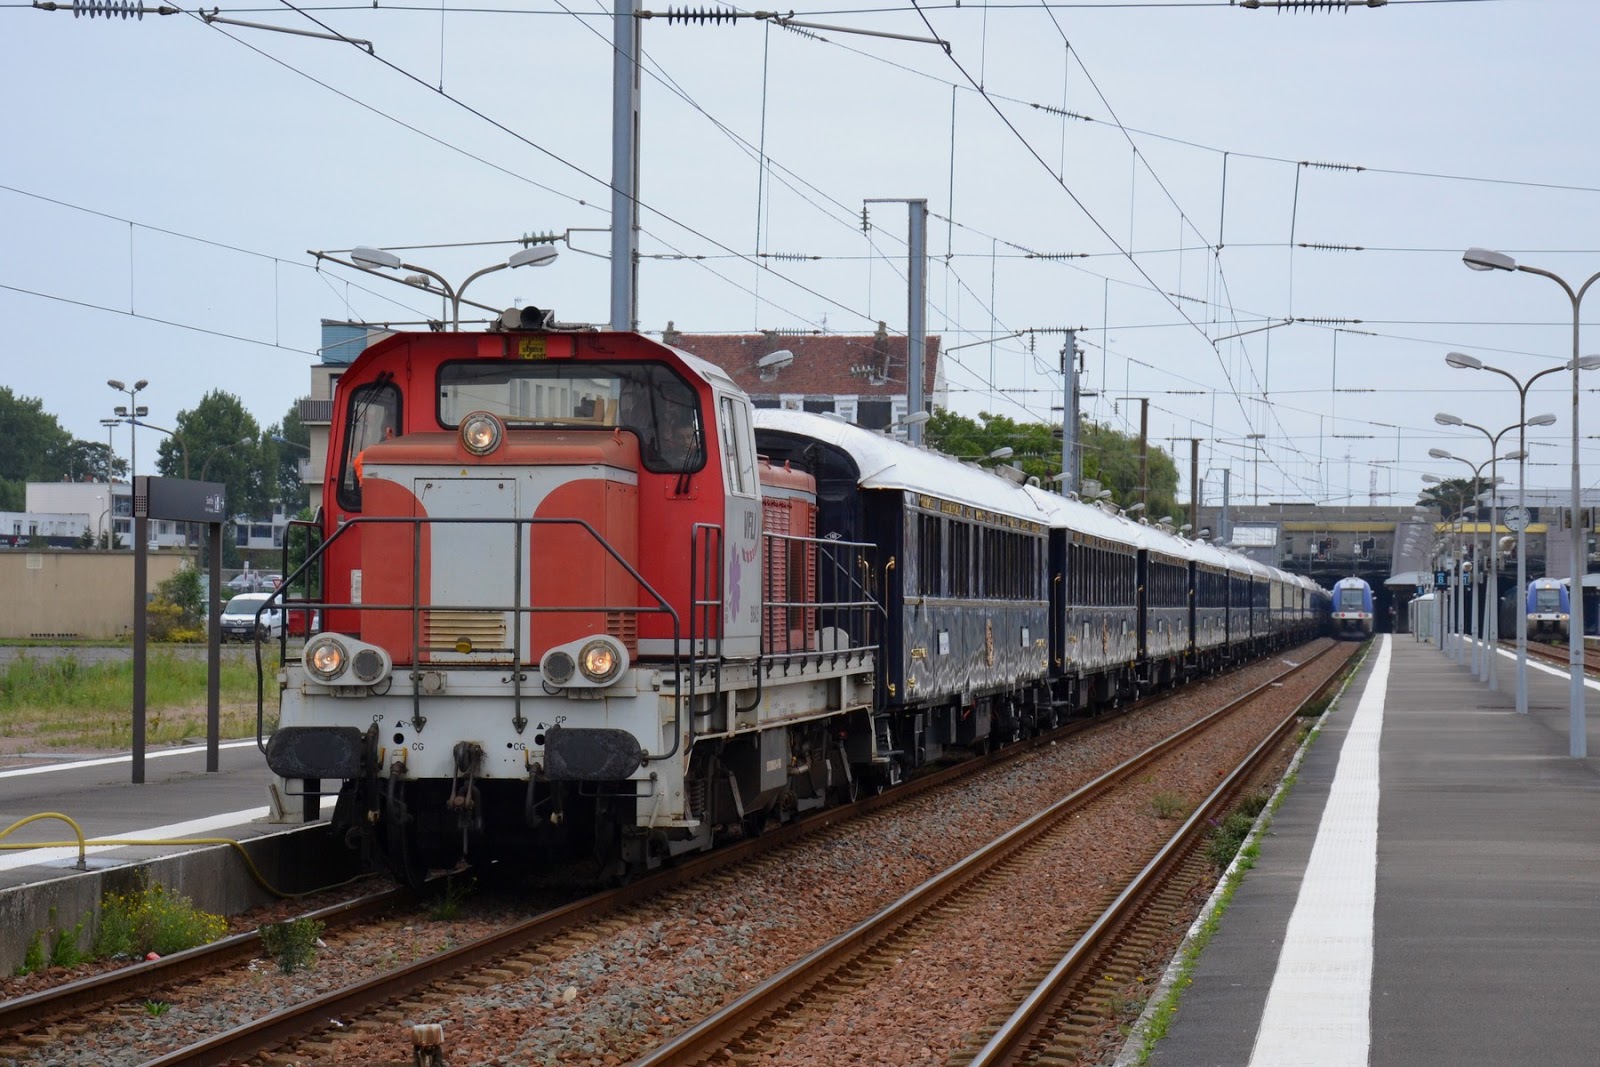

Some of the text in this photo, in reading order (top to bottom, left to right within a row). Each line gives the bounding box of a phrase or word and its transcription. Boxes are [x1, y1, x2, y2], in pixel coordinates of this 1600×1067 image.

[372, 714, 384, 723] CP
[555, 716, 567, 724] CP
[412, 742, 424, 751] CG
[513, 742, 526, 751] CG
